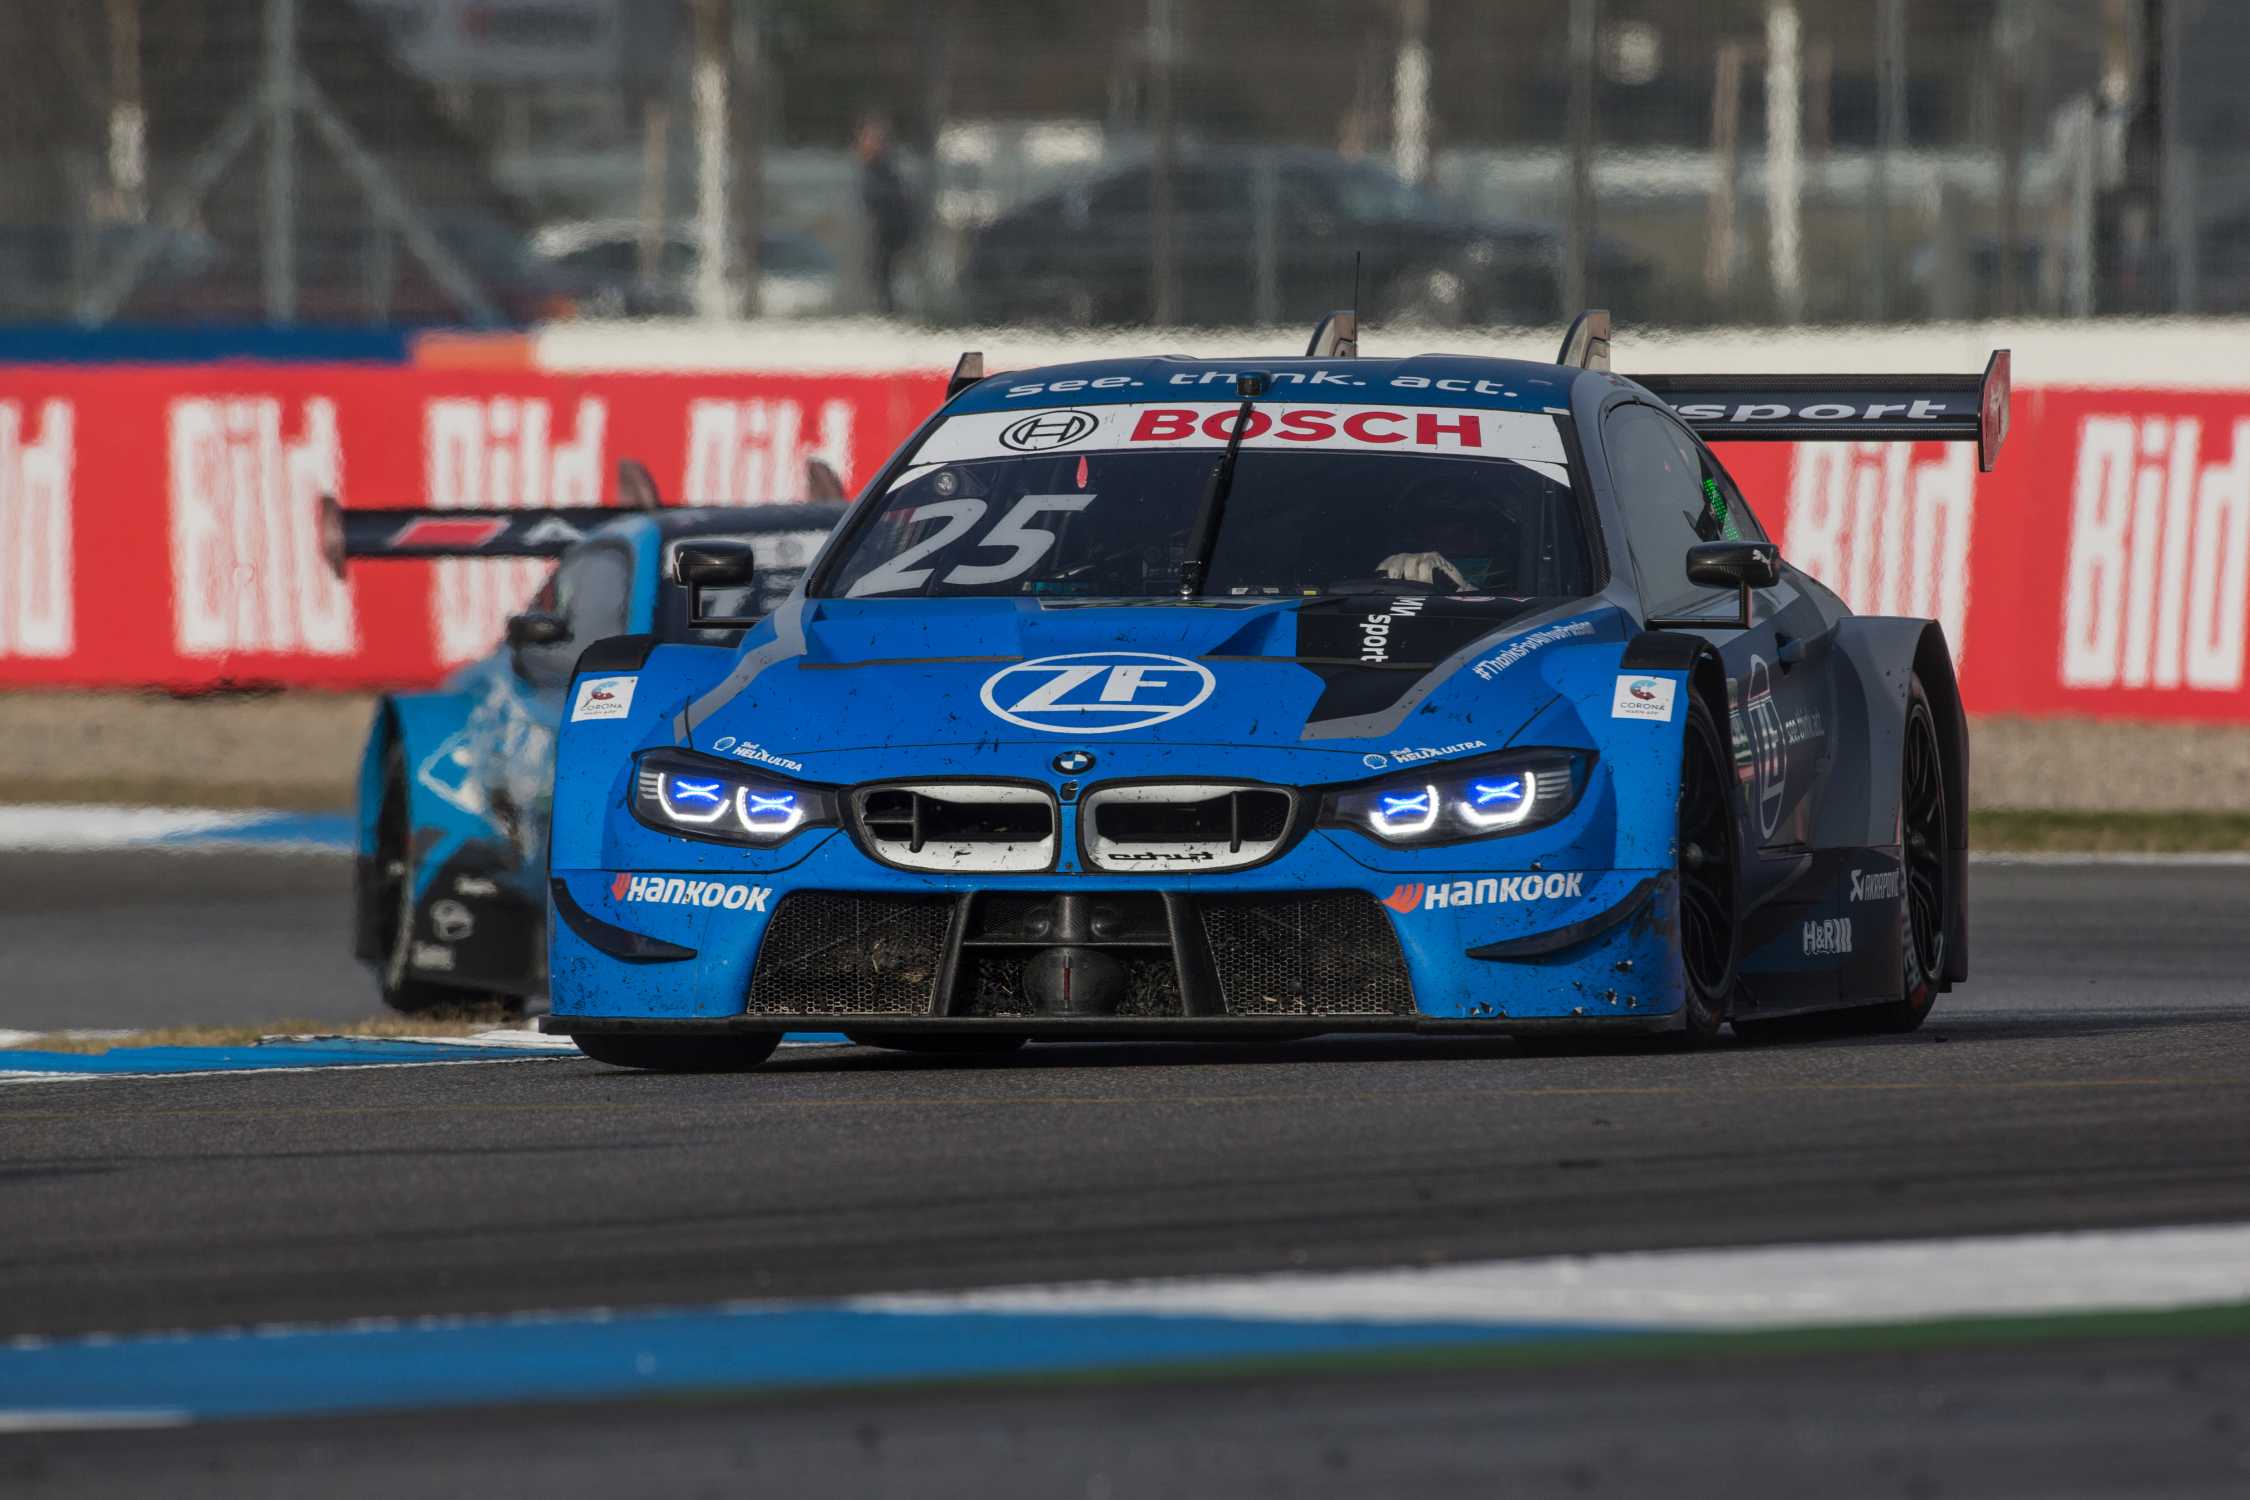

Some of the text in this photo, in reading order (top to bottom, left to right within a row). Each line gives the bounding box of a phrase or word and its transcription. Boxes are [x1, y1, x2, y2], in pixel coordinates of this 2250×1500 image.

[1004, 370, 1519, 399] see. thnk. act.
[1669, 399, 1947, 423] sport
[1129, 409, 1482, 448] BOSCH
[168, 394, 362, 657] Bild
[843, 493, 1099, 599] 25
[2059, 415, 2250, 689] Bild
[1359, 613, 1392, 663] sport
[1620, 702, 1665, 711] CORONA
[767, 756, 803, 773] ULTRA
[1441, 740, 1487, 755] ULTRA
